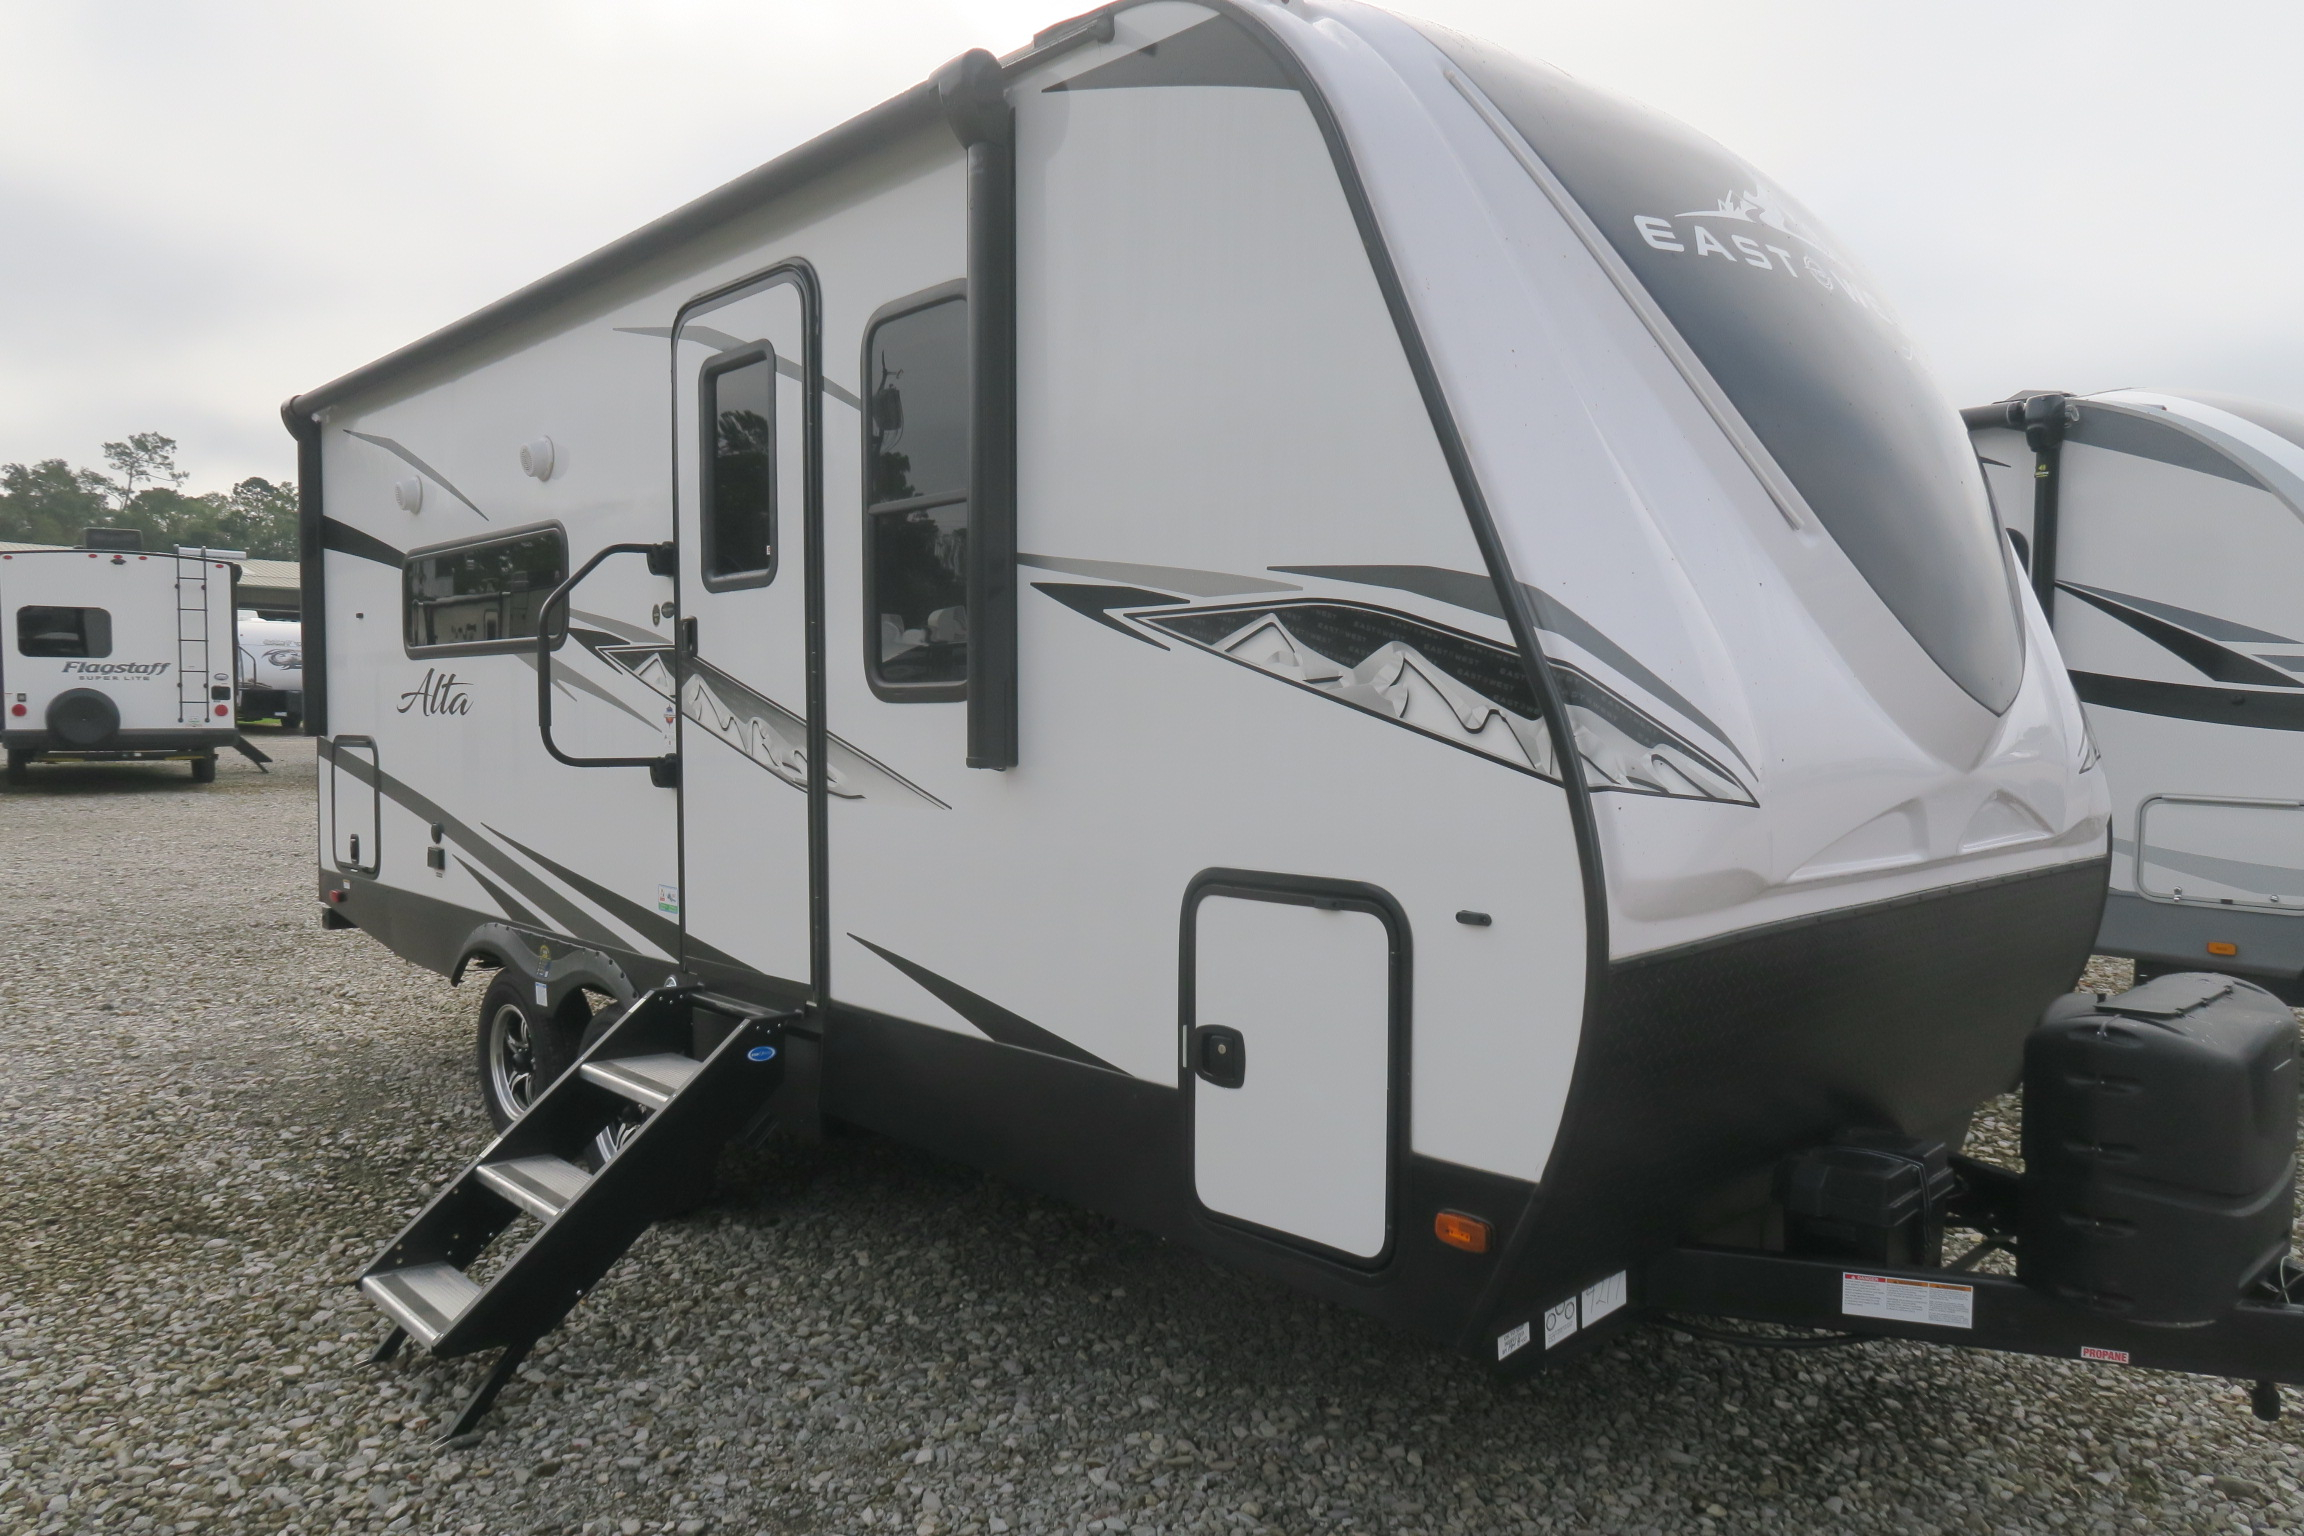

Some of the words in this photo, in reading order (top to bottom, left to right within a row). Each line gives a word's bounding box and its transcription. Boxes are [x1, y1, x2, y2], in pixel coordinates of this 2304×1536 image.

[1633, 214, 1798, 278] EAST
[62, 661, 171, 675] Flagstaff
[397, 668, 474, 716] Alta
[2083, 1348, 2127, 1362] PROPANE
